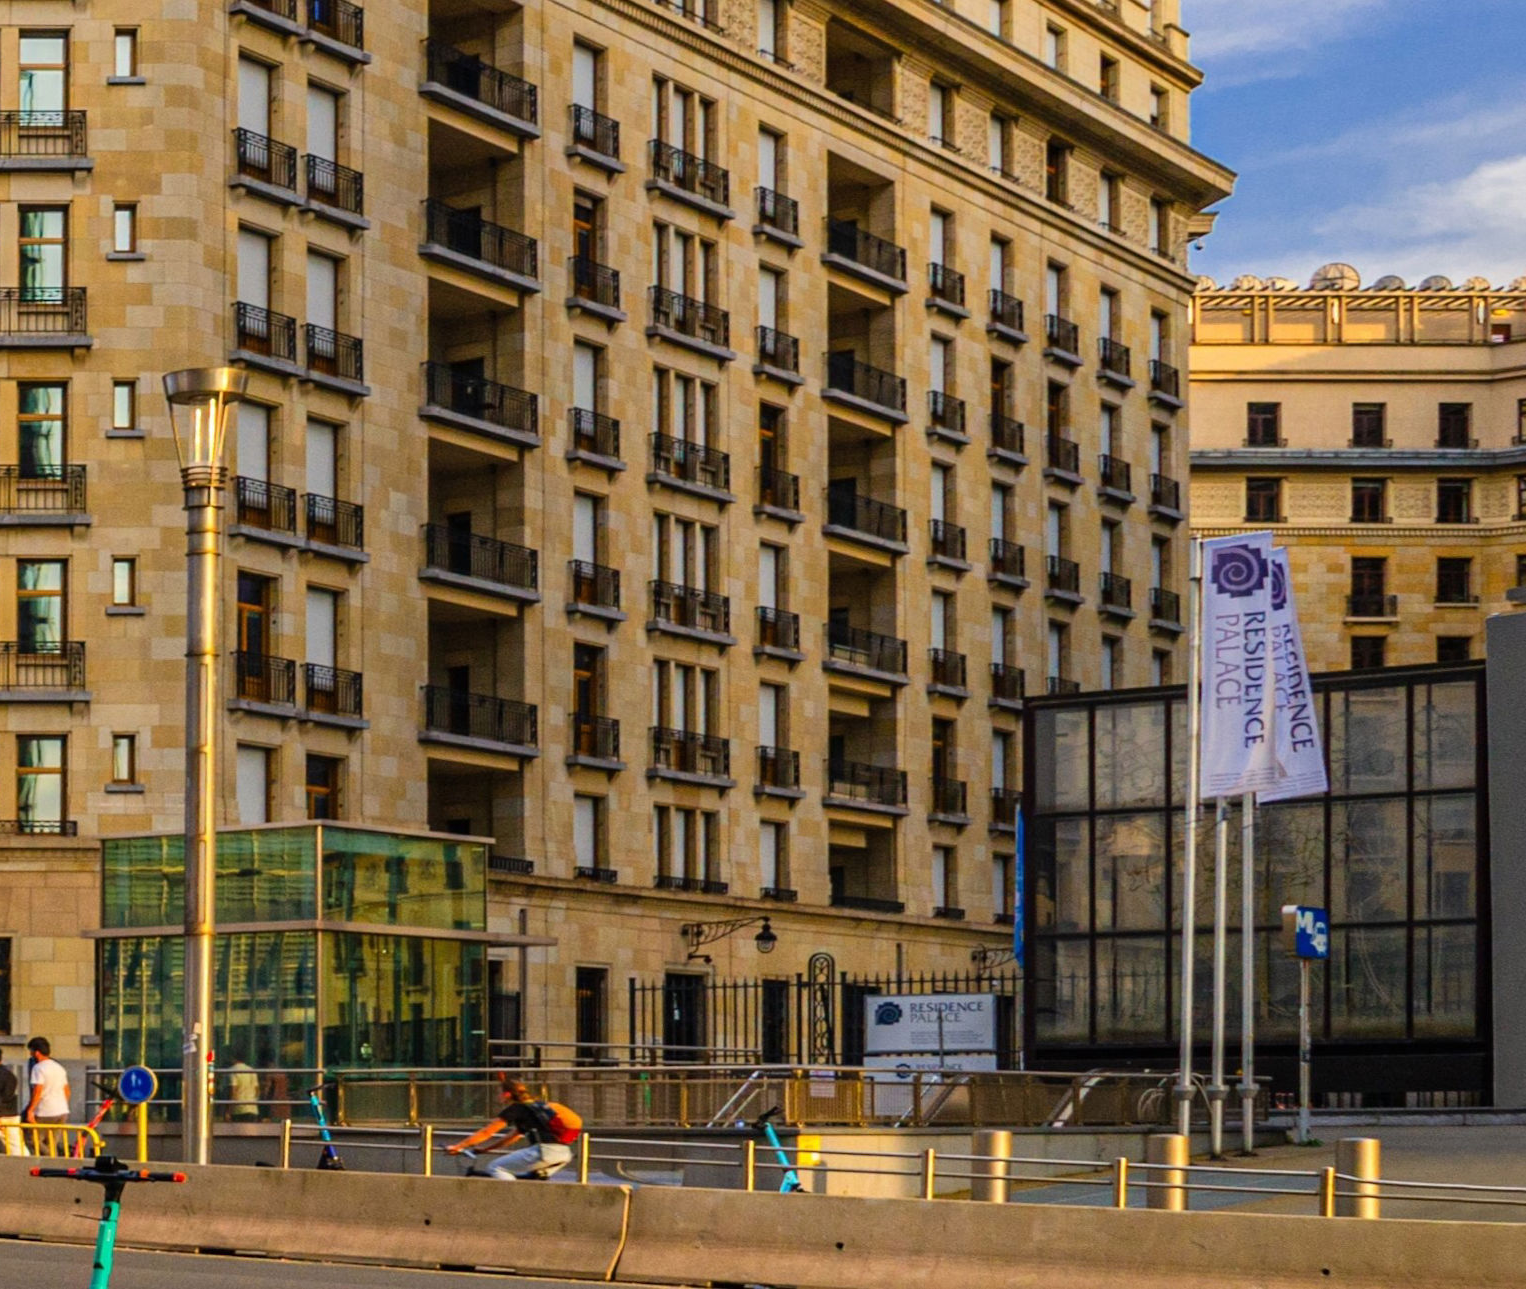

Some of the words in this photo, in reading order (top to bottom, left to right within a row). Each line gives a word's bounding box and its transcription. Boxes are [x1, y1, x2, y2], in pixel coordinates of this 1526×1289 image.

[1215, 614, 1241, 709] PALACE
[1243, 611, 1266, 749] RESIDENCE
[910, 1001, 984, 1012] RESIDENCE
[910, 1013, 961, 1023] PALACE
